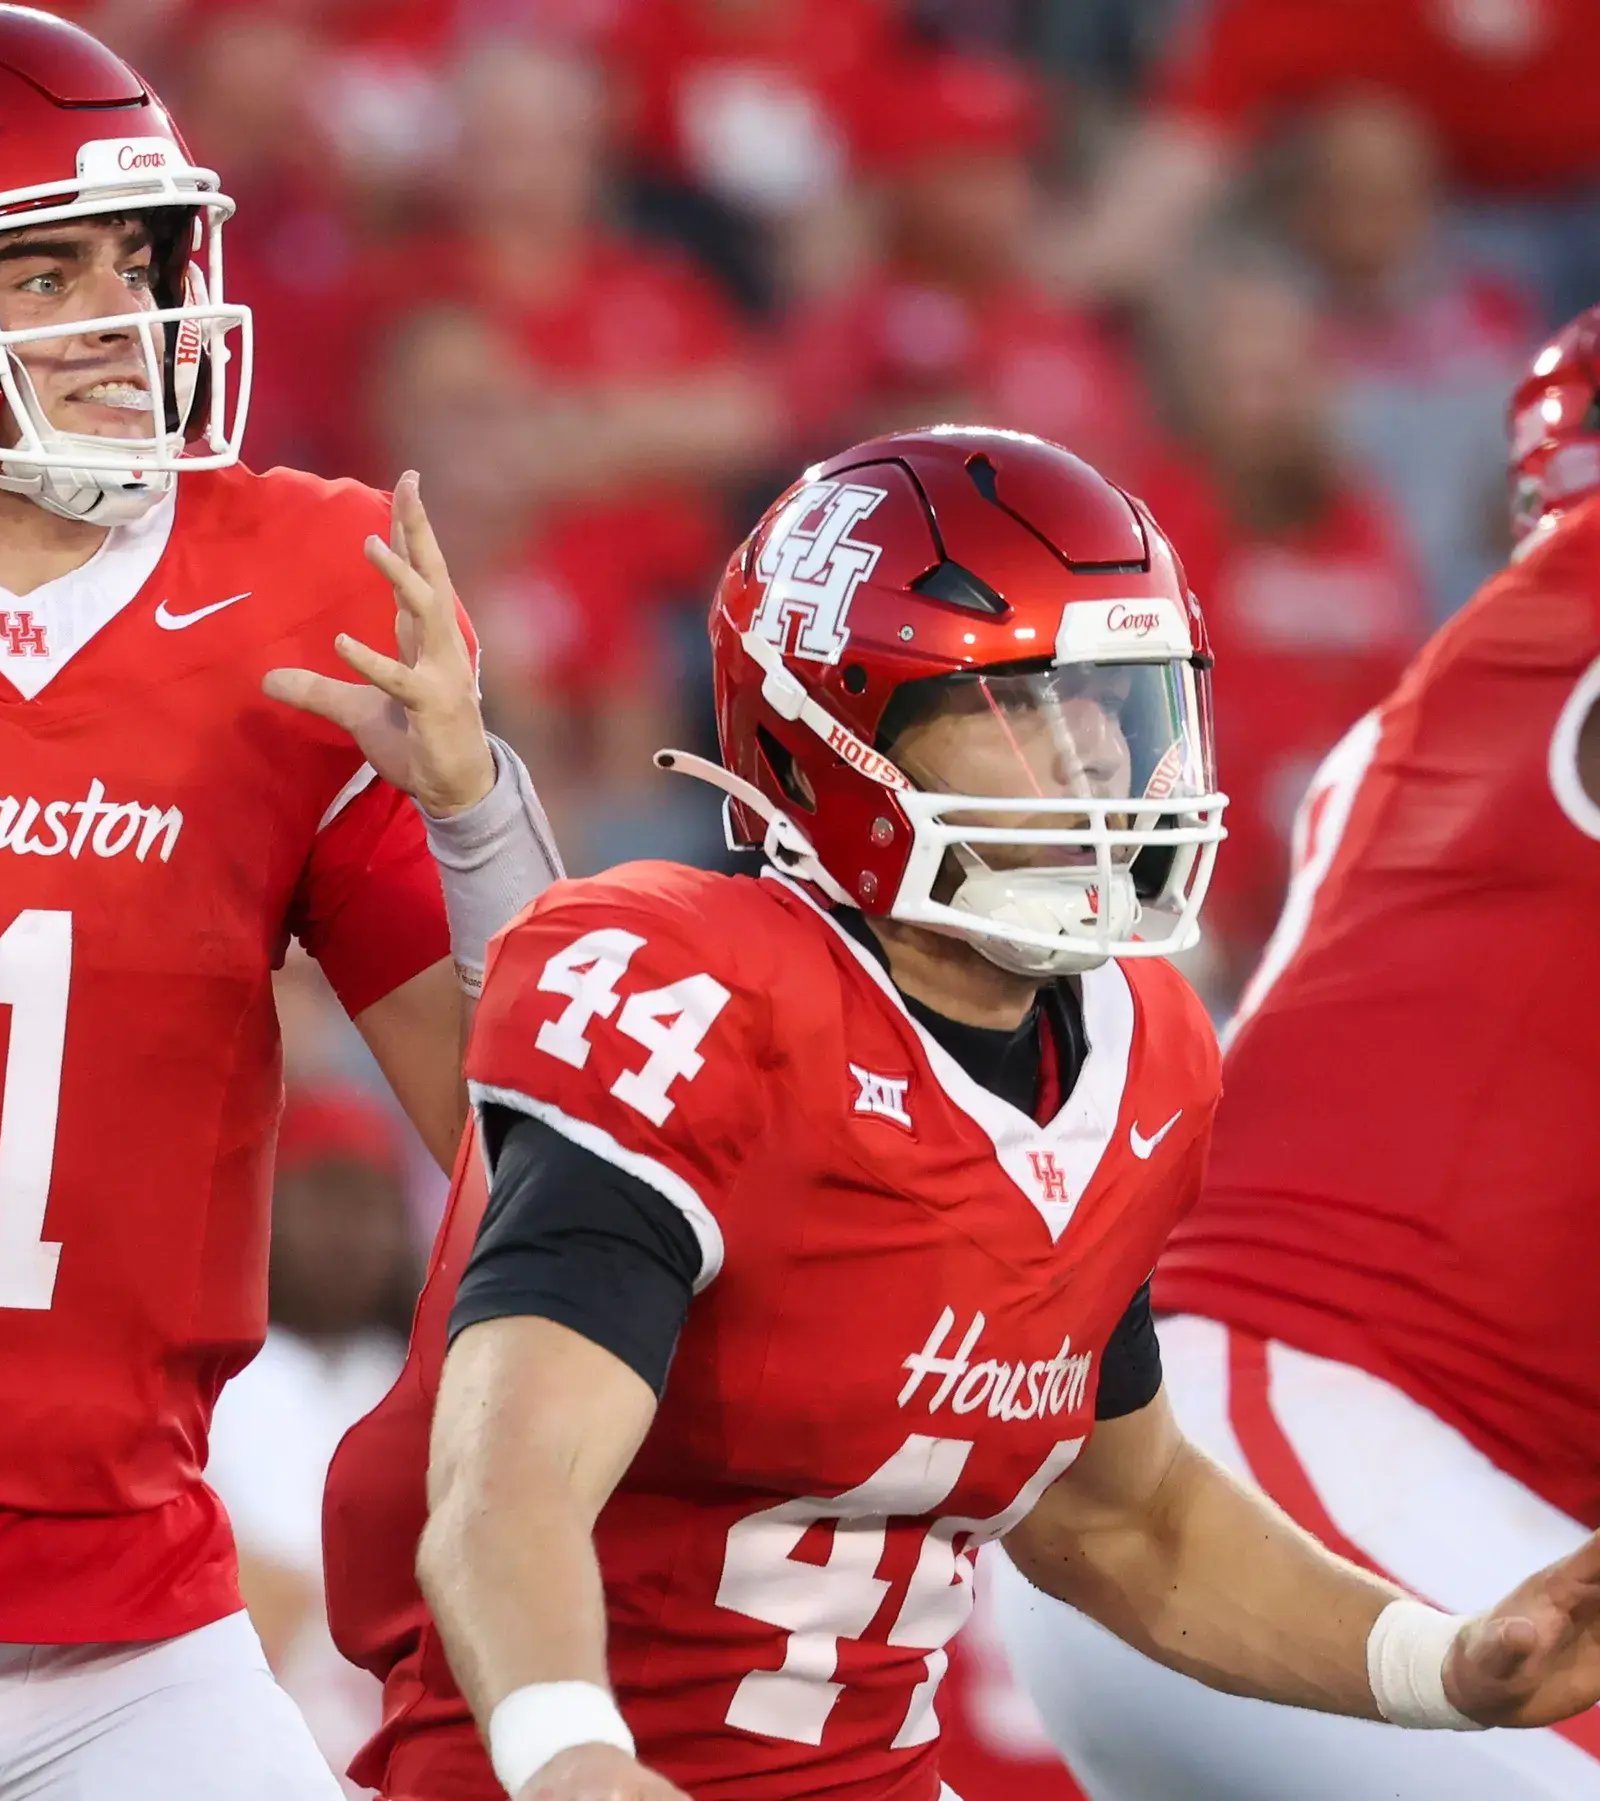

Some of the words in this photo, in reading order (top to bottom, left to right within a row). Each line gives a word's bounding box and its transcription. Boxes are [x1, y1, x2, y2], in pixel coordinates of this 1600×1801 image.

[118, 145, 166, 171] Coogs
[750, 481, 888, 665] UH
[1107, 604, 1160, 637] Coogs
[534, 927, 732, 1128] 44
[849, 1062, 913, 1129] XII
[1026, 1150, 1070, 1203] UH
[898, 1304, 1093, 1422] Houston
[715, 1432, 1087, 1750] 44
